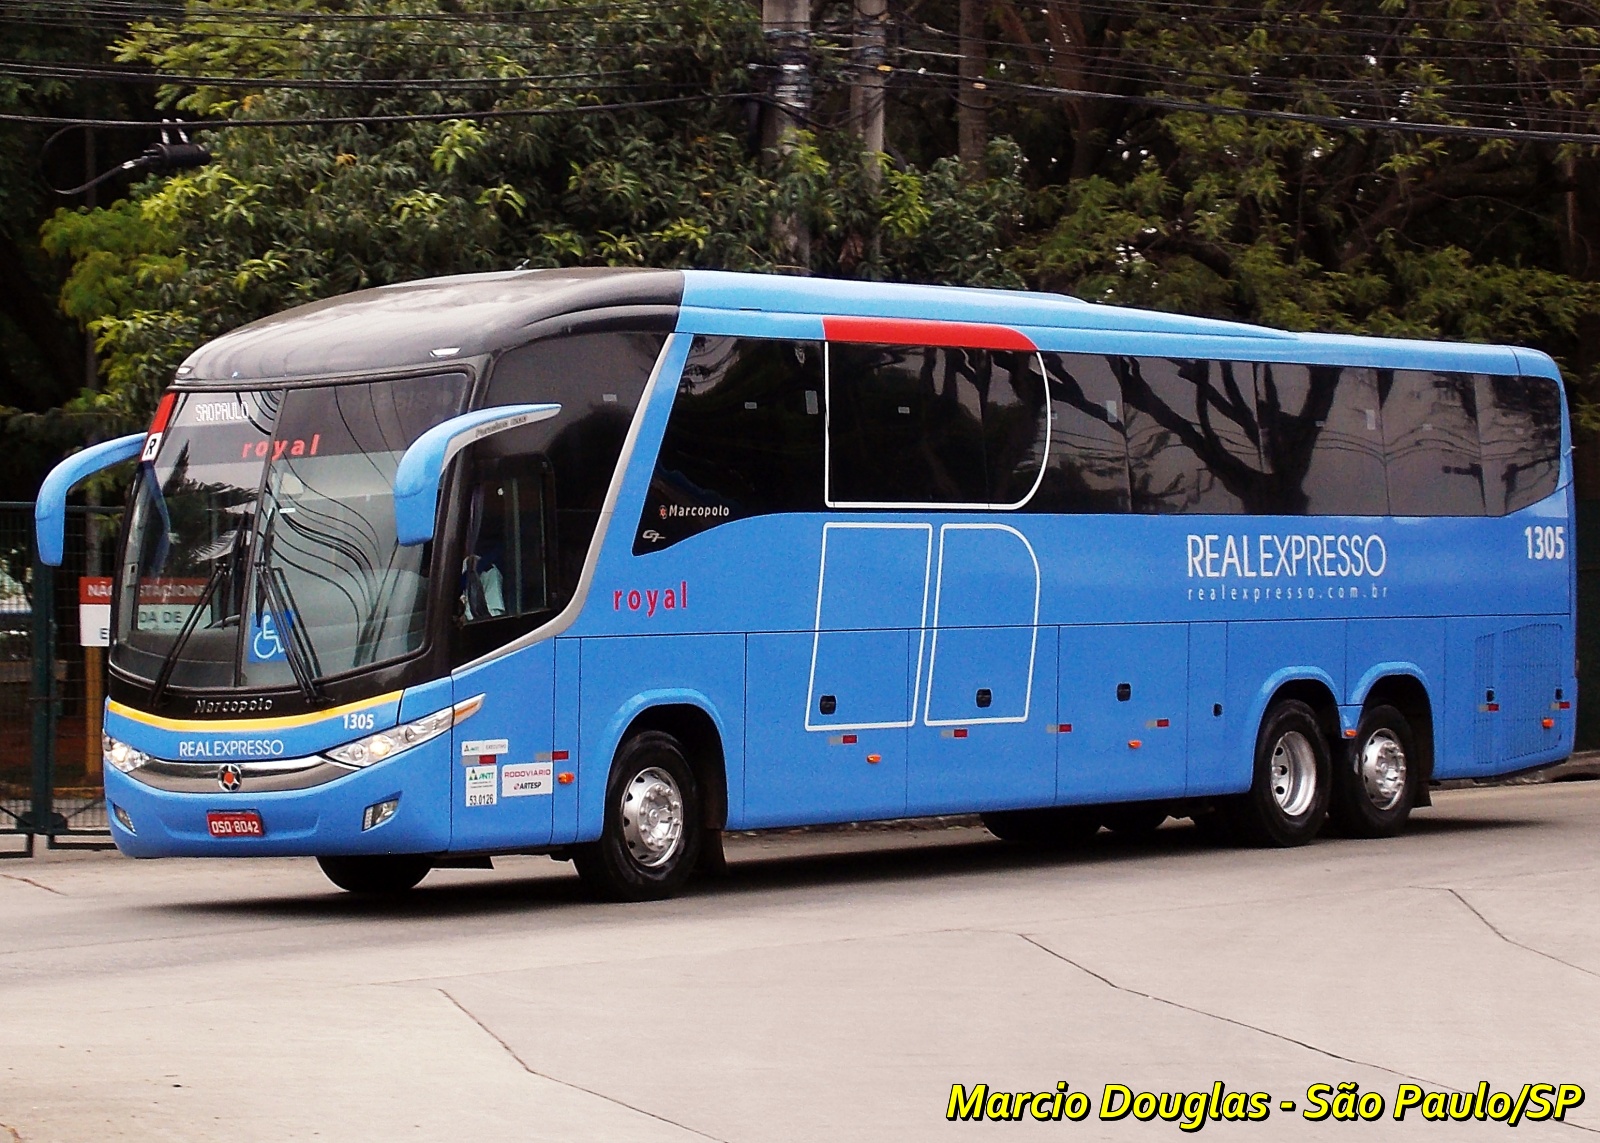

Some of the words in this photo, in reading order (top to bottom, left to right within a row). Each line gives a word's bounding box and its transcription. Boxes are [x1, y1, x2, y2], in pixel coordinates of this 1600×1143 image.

[146, 438, 157, 456] R
[241, 433, 320, 461] royal
[669, 504, 730, 518] Marcopolo
[1524, 525, 1565, 560] 1305
[613, 580, 687, 617] royal
[1188, 583, 1387, 603] realexpresso.com.br
[194, 697, 272, 714] Marcopolo
[342, 713, 374, 730] 1305
[478, 772, 494, 780] ANTT
[519, 781, 542, 790] ARTESP
[469, 793, 494, 806] 53.0126
